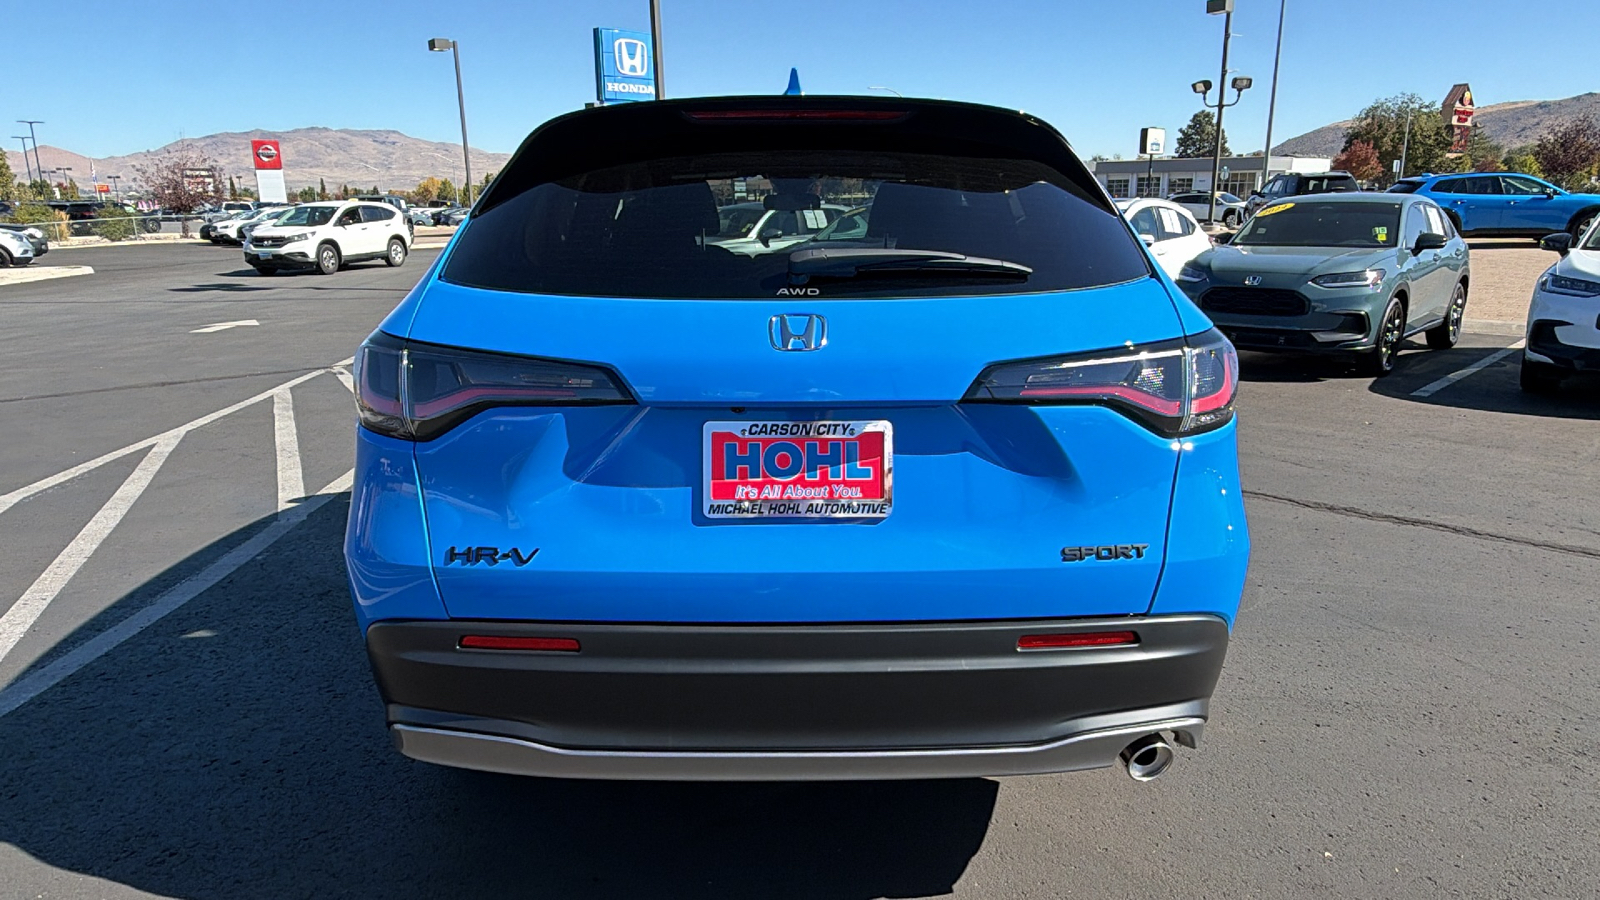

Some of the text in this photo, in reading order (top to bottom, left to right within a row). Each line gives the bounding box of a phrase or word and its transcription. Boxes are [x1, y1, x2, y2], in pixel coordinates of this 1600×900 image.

[606, 82, 655, 94] HONDA
[776, 287, 820, 296] AWD
[748, 423, 852, 436] CARSON CITY
[724, 441, 873, 481] HOHL
[735, 484, 863, 498] It's All About You.
[708, 503, 888, 515] MICHAEL HOHL AUTOMOTIVE
[447, 546, 540, 565] HR-V
[1061, 544, 1149, 562] SPORT
